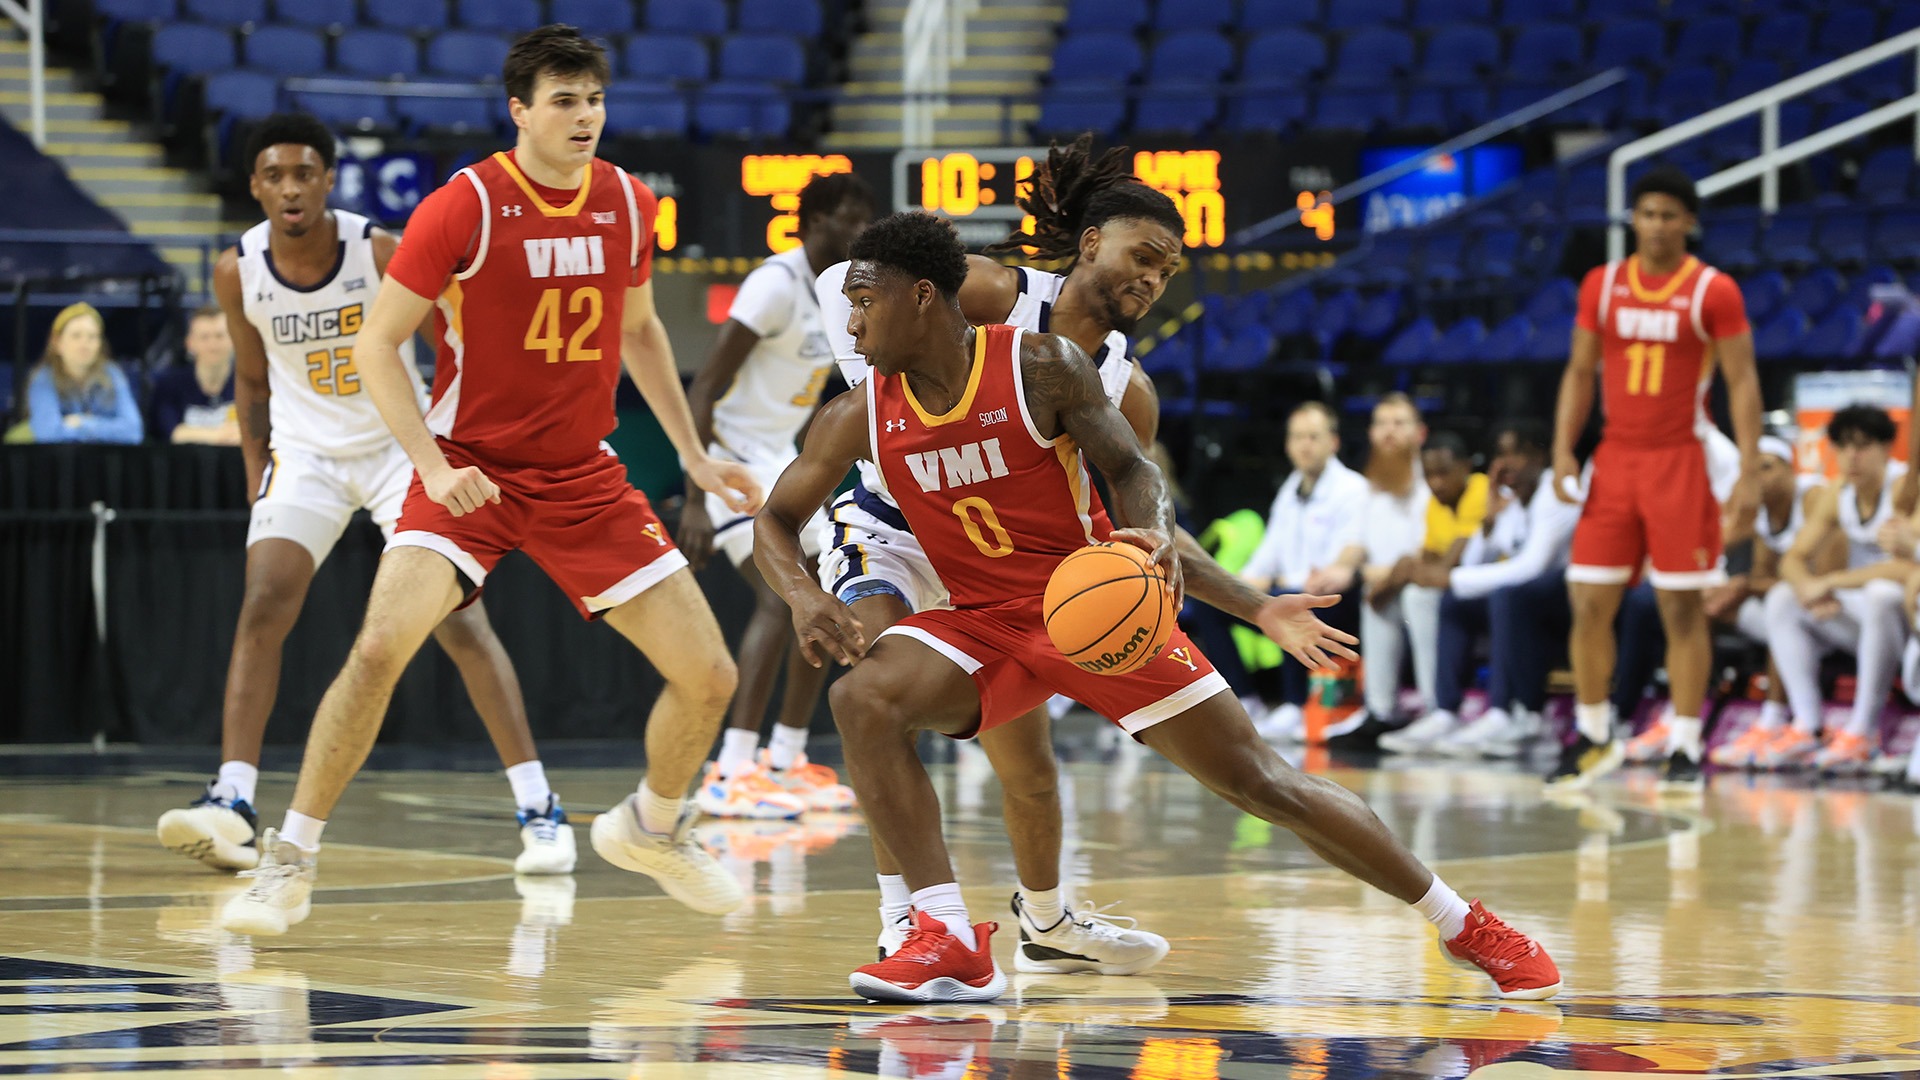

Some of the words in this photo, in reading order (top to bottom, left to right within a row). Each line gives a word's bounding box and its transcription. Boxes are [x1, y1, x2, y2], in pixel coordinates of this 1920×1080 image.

[523, 235, 606, 279] VMI
[272, 302, 364, 345] UNCG
[523, 286, 604, 364] 42
[1616, 306, 1679, 342] VMI
[305, 345, 362, 397] 22
[1625, 342, 1666, 396] 11
[978, 407, 1009, 428] SOCON
[904, 437, 1010, 493] VMI
[952, 496, 1015, 558] 0
[1076, 626, 1150, 672] Wilson
